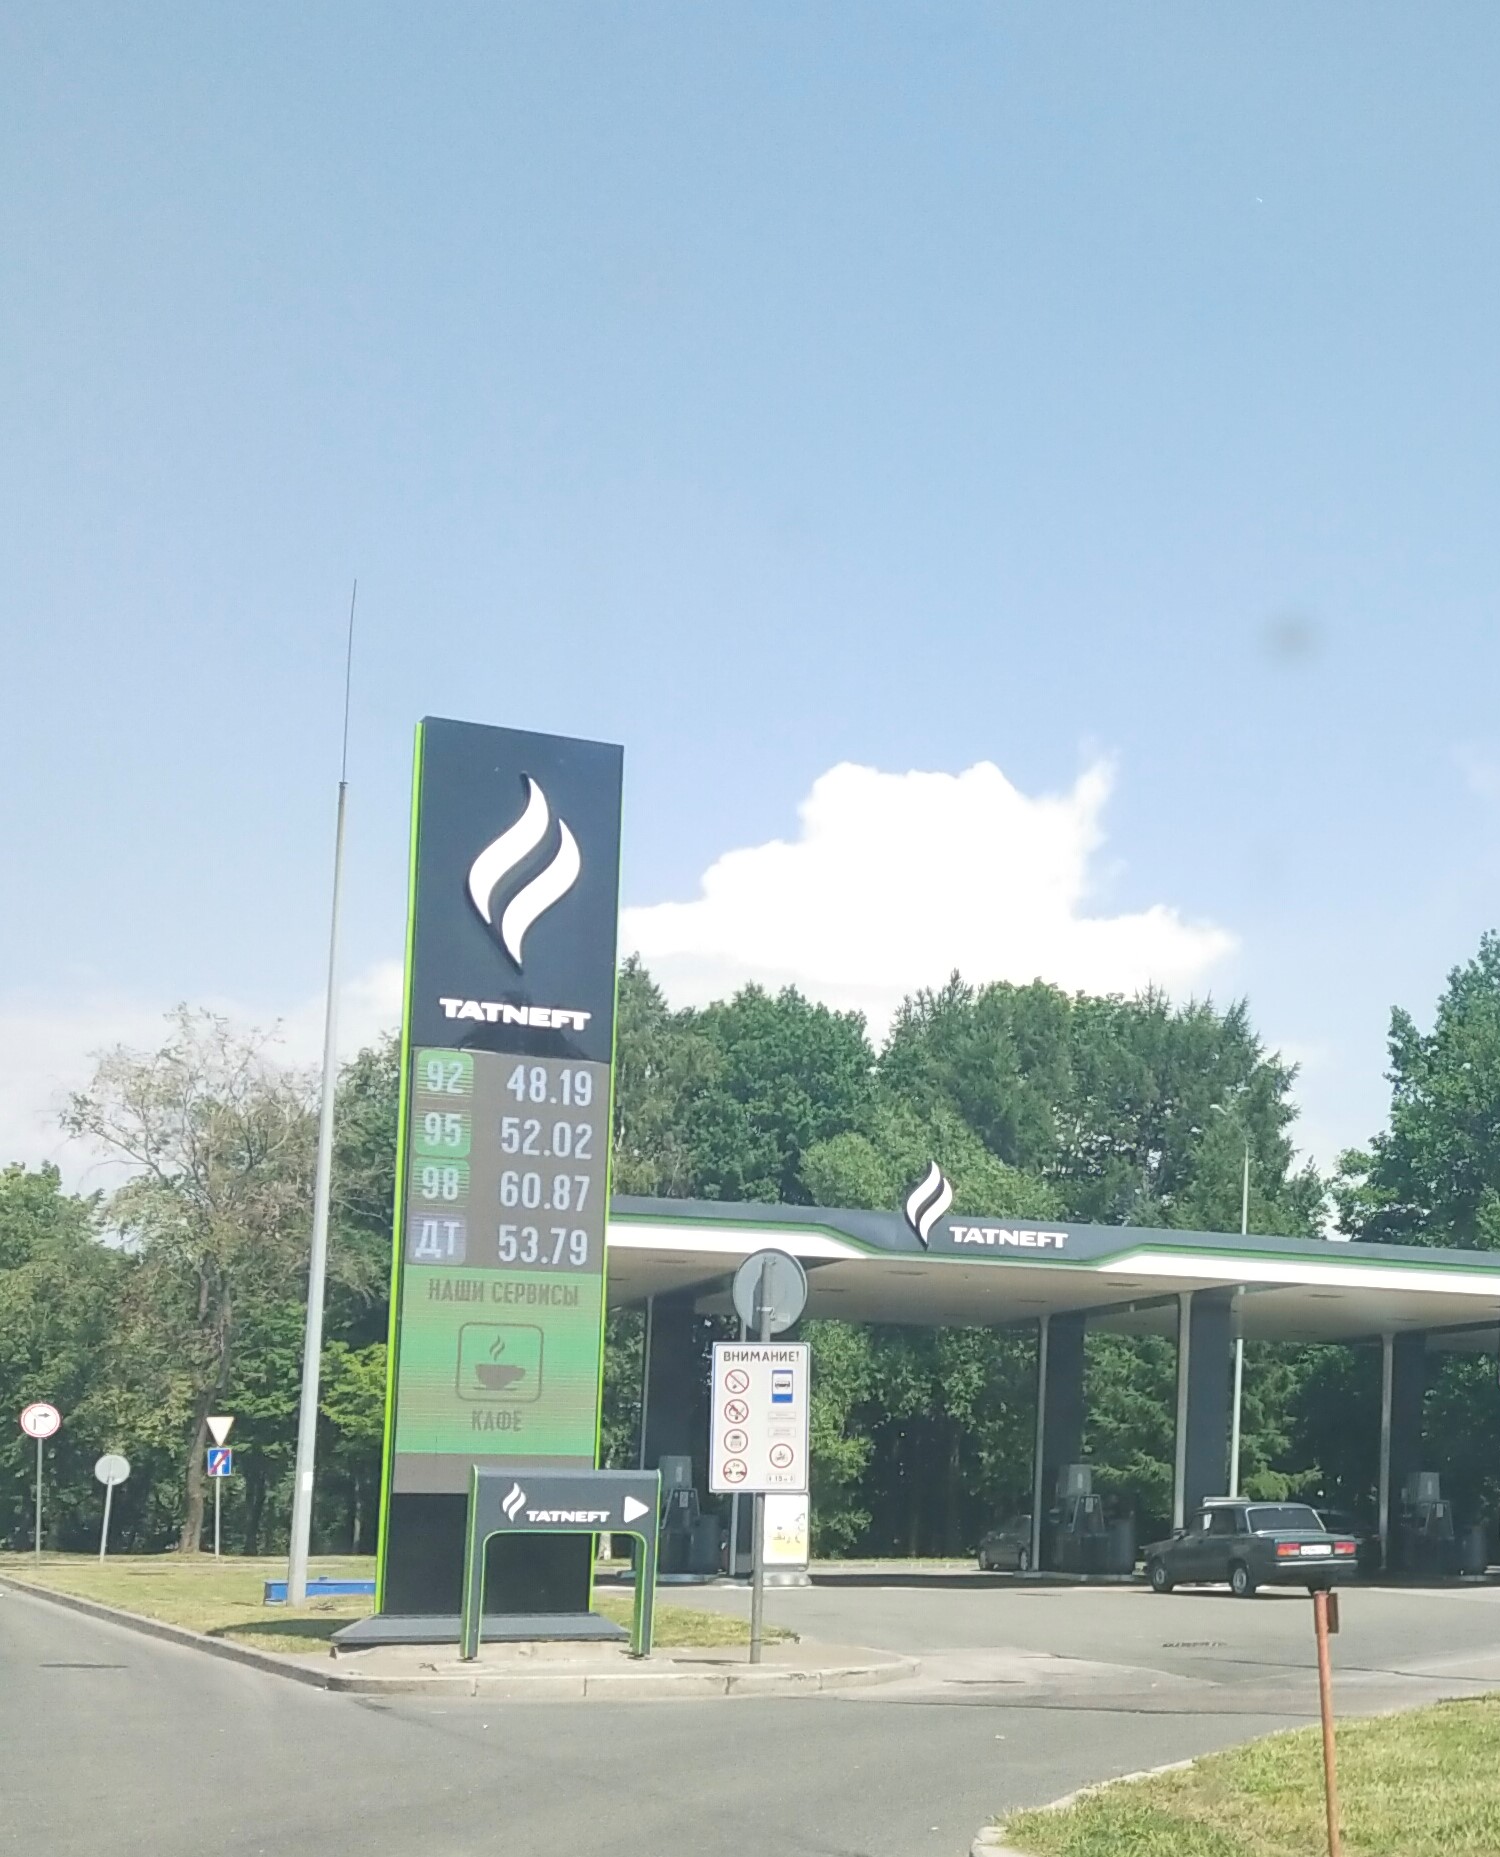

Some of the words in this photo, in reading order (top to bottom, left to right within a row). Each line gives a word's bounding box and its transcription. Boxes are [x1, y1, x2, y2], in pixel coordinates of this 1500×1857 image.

[440, 998, 592, 1031] TATNEFT
[427, 1060, 465, 1094] 92
[507, 1064, 593, 1107] 48.19
[424, 1111, 462, 1147] 95
[501, 1116, 593, 1161] 52.02
[422, 1166, 460, 1201] 98
[500, 1170, 591, 1212] 60.87
[414, 1219, 461, 1259] ДТ
[498, 1224, 588, 1266] 53.79
[948, 1226, 1069, 1249] TATNEFT
[429, 1278, 484, 1303] НАШИ
[492, 1281, 579, 1307] СЕРВИСЫ
[722, 1350, 801, 1363] ВНИМАНИЕ!
[471, 1409, 523, 1432] КАФЕ
[526, 1510, 611, 1523] TATNEFT
